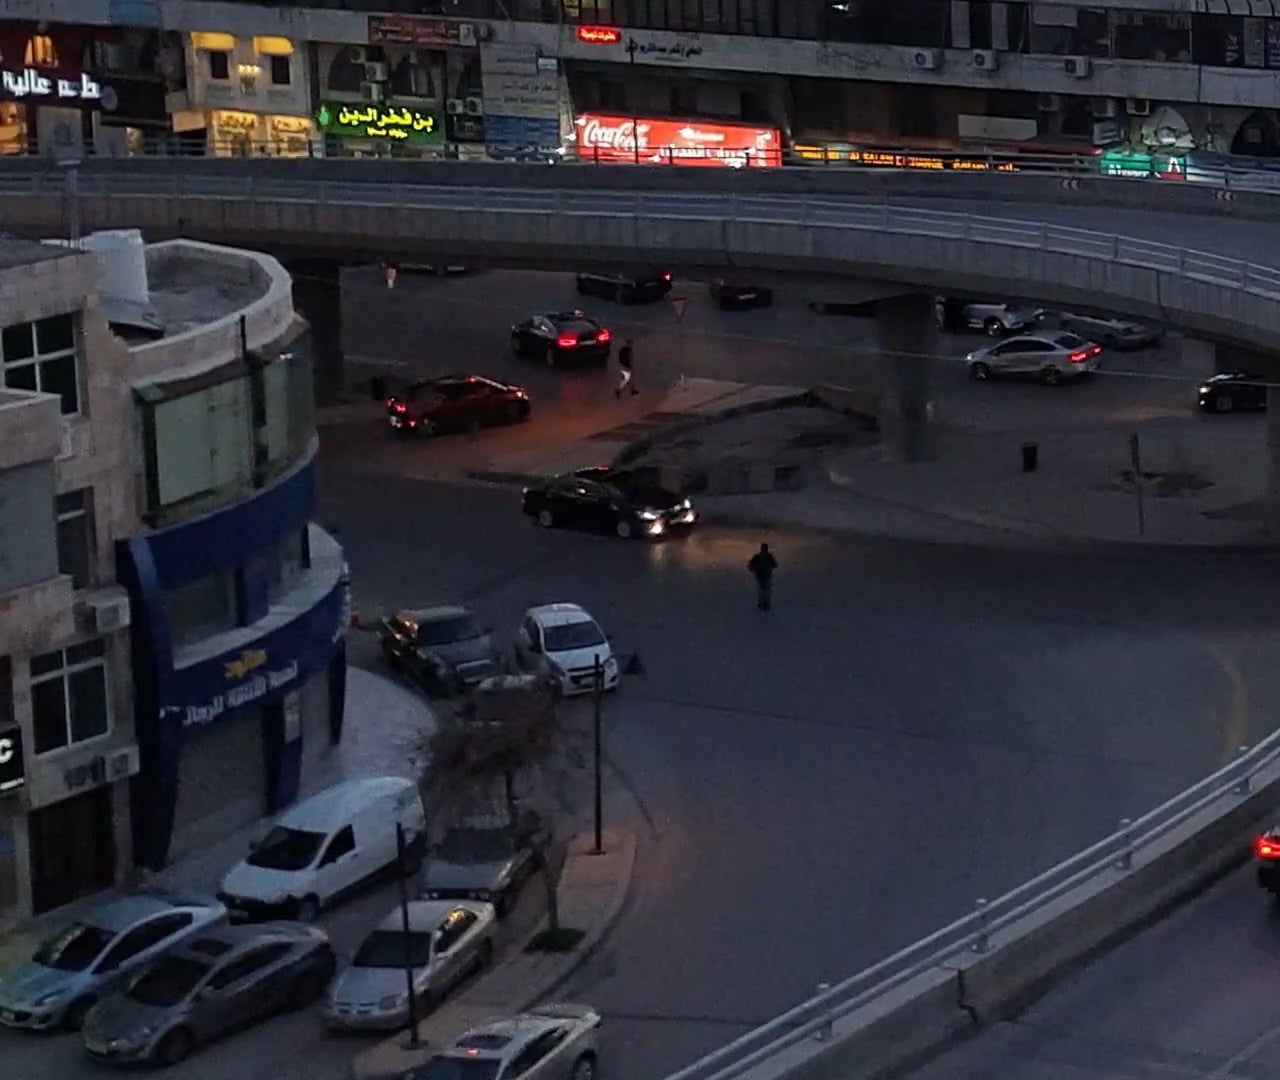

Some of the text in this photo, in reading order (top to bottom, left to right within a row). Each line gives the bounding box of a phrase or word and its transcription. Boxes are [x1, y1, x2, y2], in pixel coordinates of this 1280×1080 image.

[339, 106, 377, 126] الدين
[377, 107, 412, 127] فخر
[413, 112, 434, 133] بن
